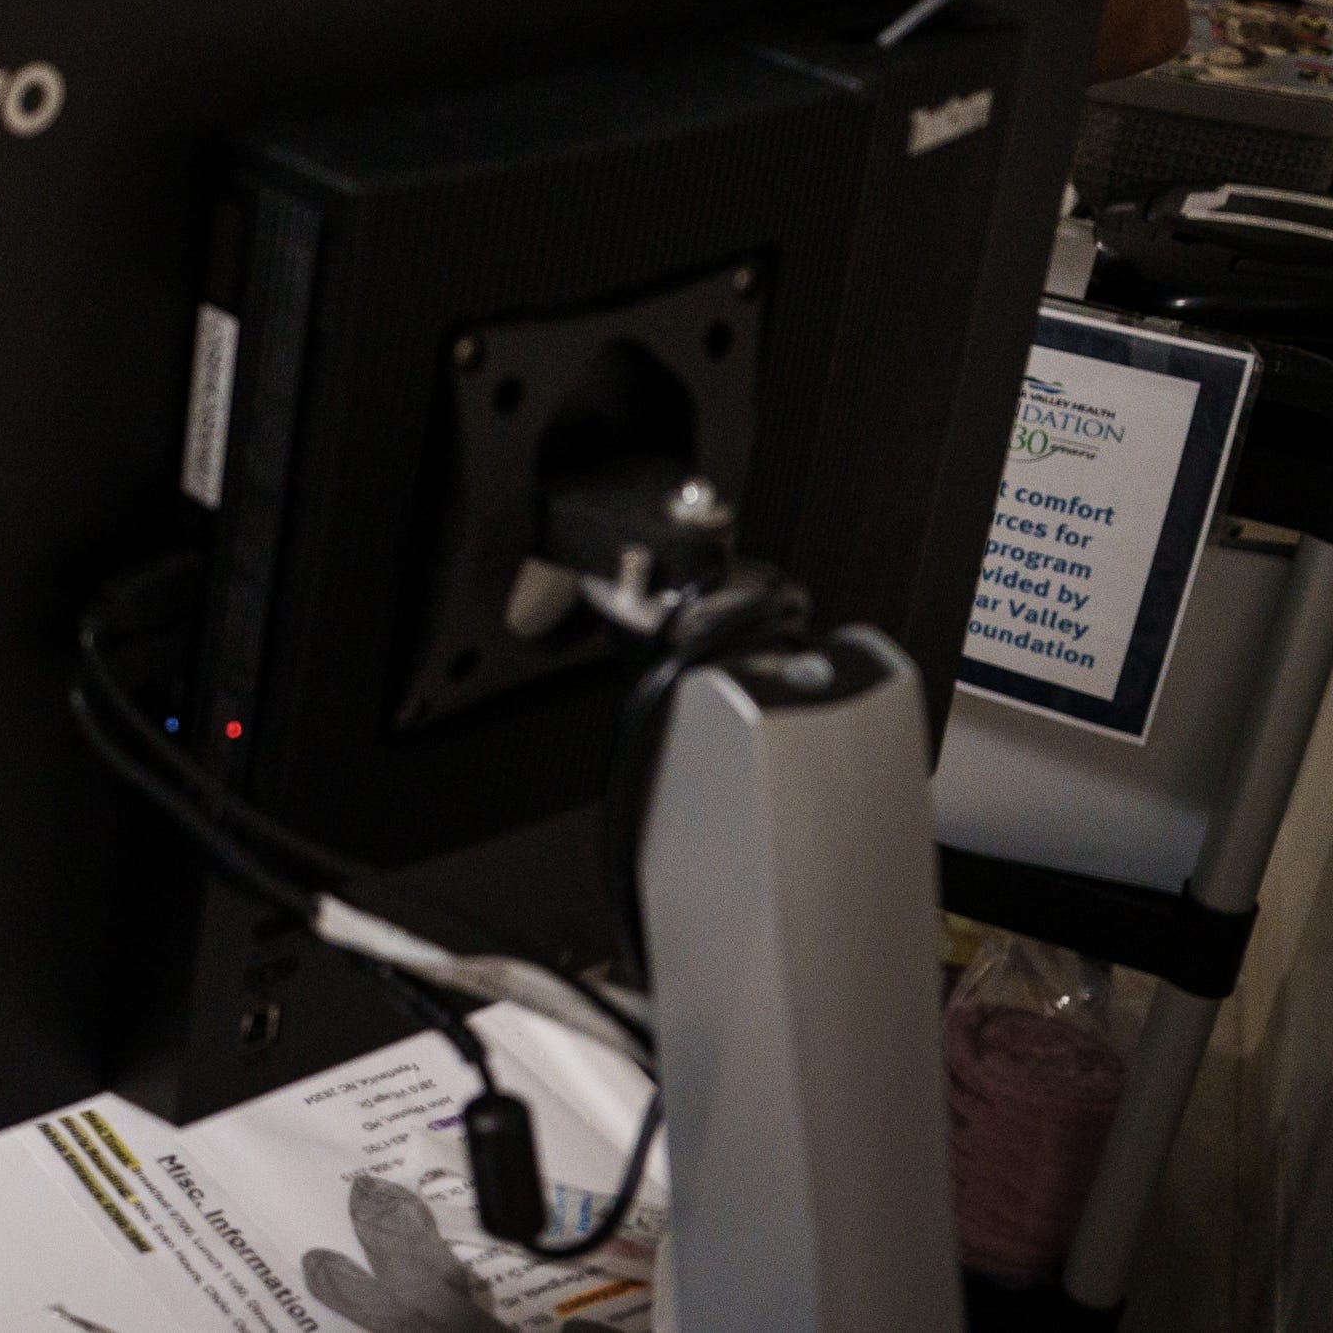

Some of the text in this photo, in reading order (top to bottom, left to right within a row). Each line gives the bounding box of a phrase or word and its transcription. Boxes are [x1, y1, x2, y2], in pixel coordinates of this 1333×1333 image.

[1017, 402, 1126, 444] DATION
[1030, 394, 1071, 408] VALLEY
[1072, 401, 1116, 419] HEALTH
[1015, 487, 1115, 526] comfort
[1055, 523, 1093, 549] for
[984, 539, 1092, 580] program
[982, 567, 1090, 611] vided by
[976, 594, 1090, 641] ar Valley
[968, 619, 1096, 669] oundation
[157, 1154, 319, 1333] Misc. Information
